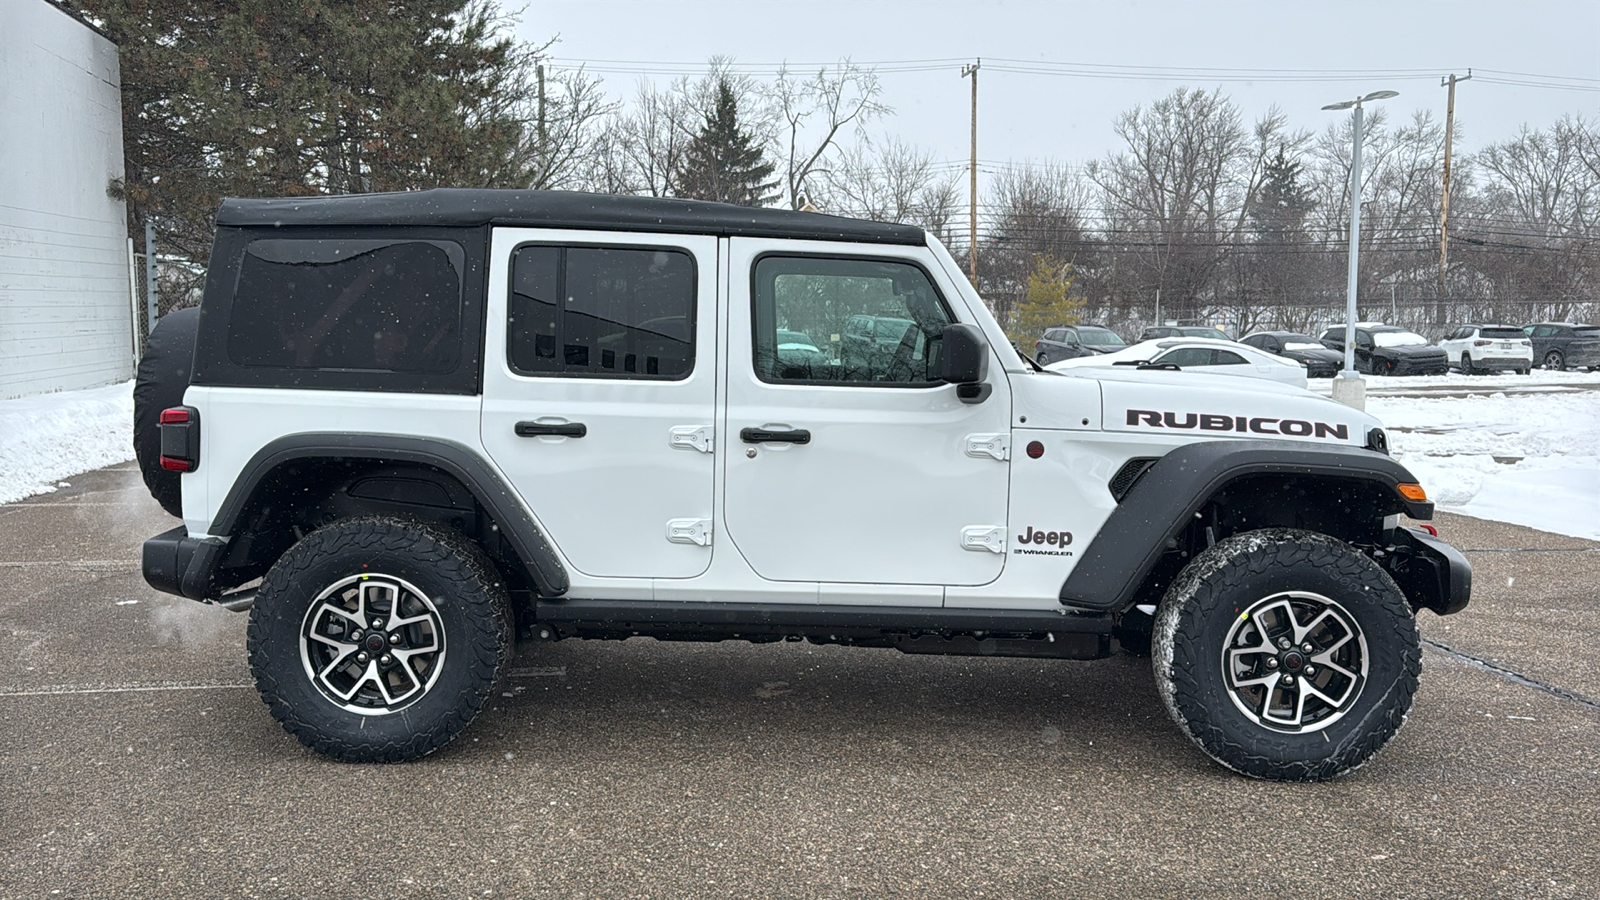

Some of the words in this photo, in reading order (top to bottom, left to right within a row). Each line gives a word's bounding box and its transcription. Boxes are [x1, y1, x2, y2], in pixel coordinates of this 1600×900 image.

[1126, 409, 1349, 440] RUBICON
[1017, 525, 1073, 549] Jeep
[1023, 549, 1073, 557] WRANGLER
